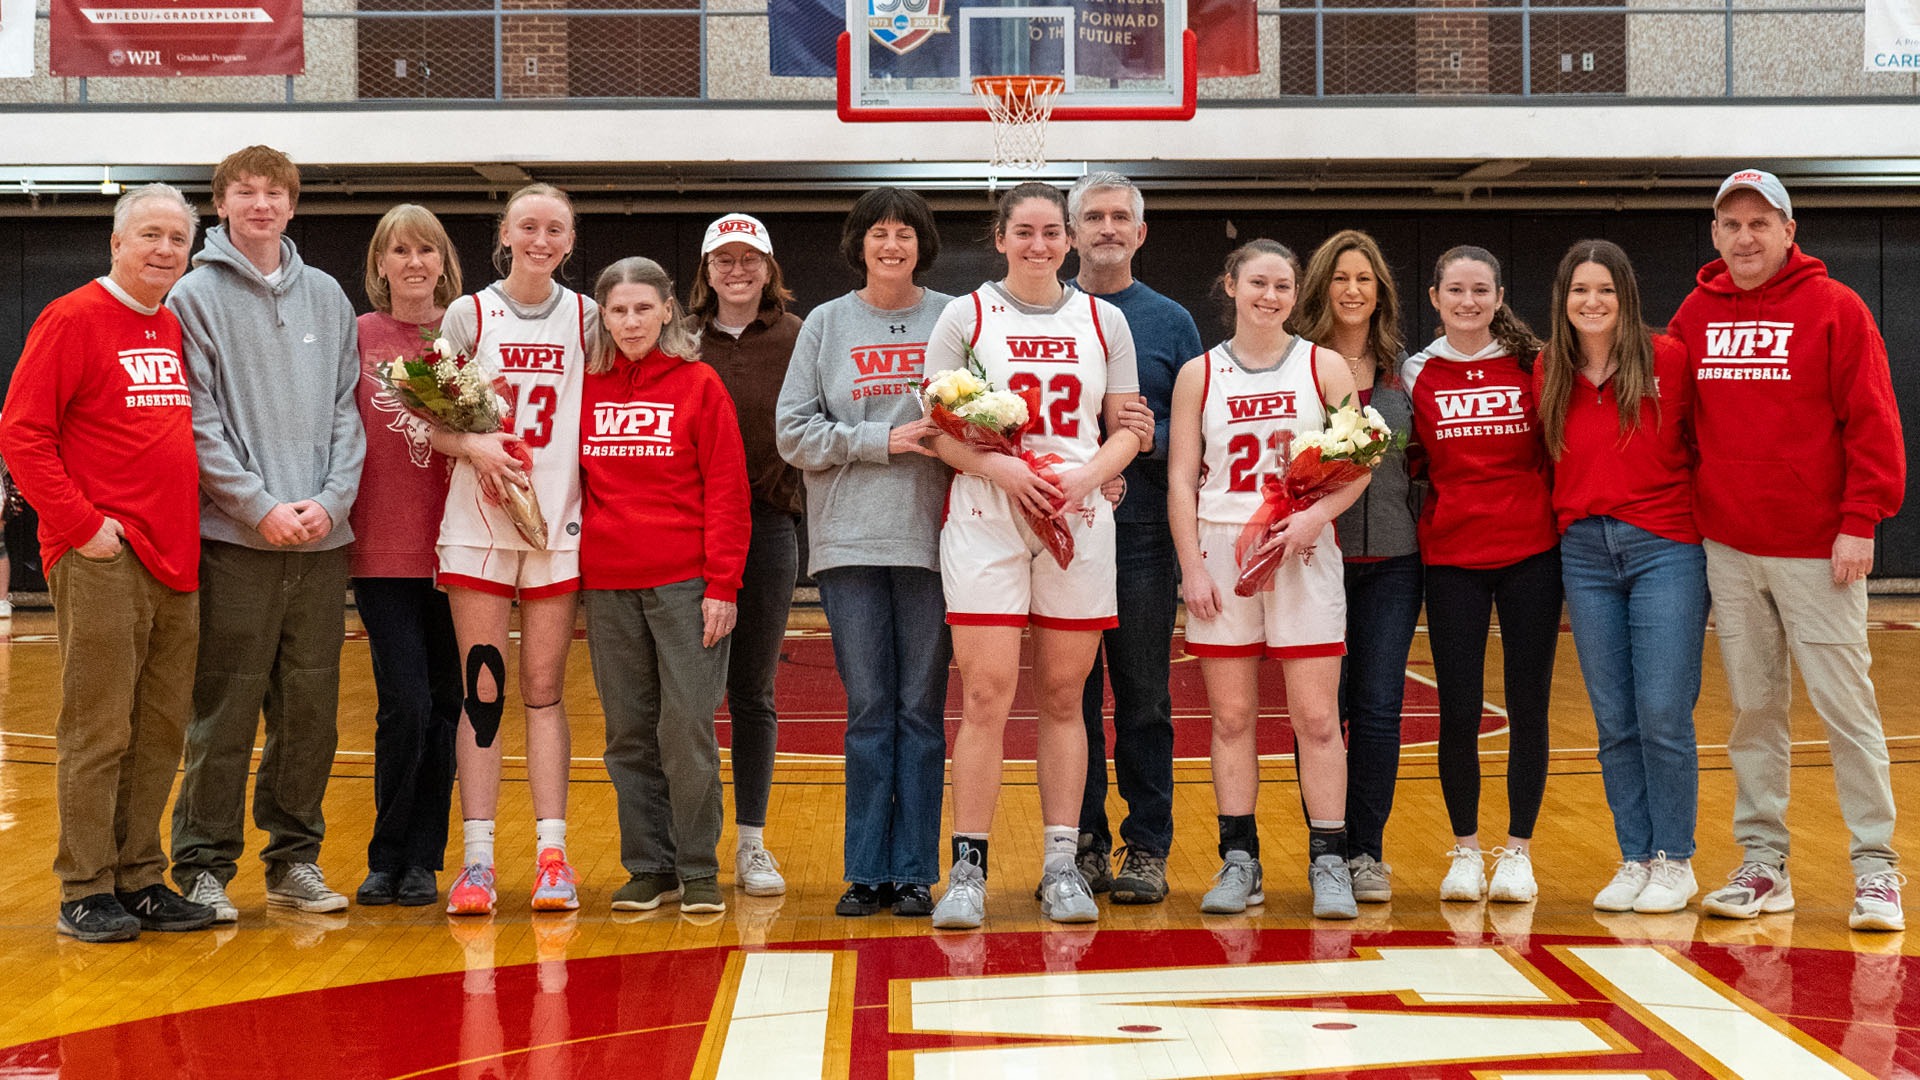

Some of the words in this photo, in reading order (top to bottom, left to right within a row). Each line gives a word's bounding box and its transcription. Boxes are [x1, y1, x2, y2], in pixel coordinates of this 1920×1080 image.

[95, 12, 256, 20] WPI.EDU/+GRADEXPLORE
[869, 18, 889, 28] 1973
[1081, 11, 1159, 27] FORWARD
[1079, 26, 1137, 46] FUTURE.
[126, 50, 162, 66] WPI
[176, 54, 210, 62] Graduate
[211, 53, 247, 63] Programs
[718, 221, 757, 236] WPI
[1006, 340, 1079, 359] WPI
[1705, 328, 1793, 357] WPI
[499, 347, 565, 370] WPI
[850, 348, 926, 376] WP
[119, 354, 187, 385] WPI
[1697, 367, 1792, 381] BASKETBALL
[851, 382, 912, 401] BASKET
[1227, 395, 1297, 419] WPI
[1435, 390, 1524, 419] WPI
[593, 407, 675, 437] WPI
[1435, 422, 1531, 441] BASKETBALL
[582, 444, 675, 457] BASKETBALL
